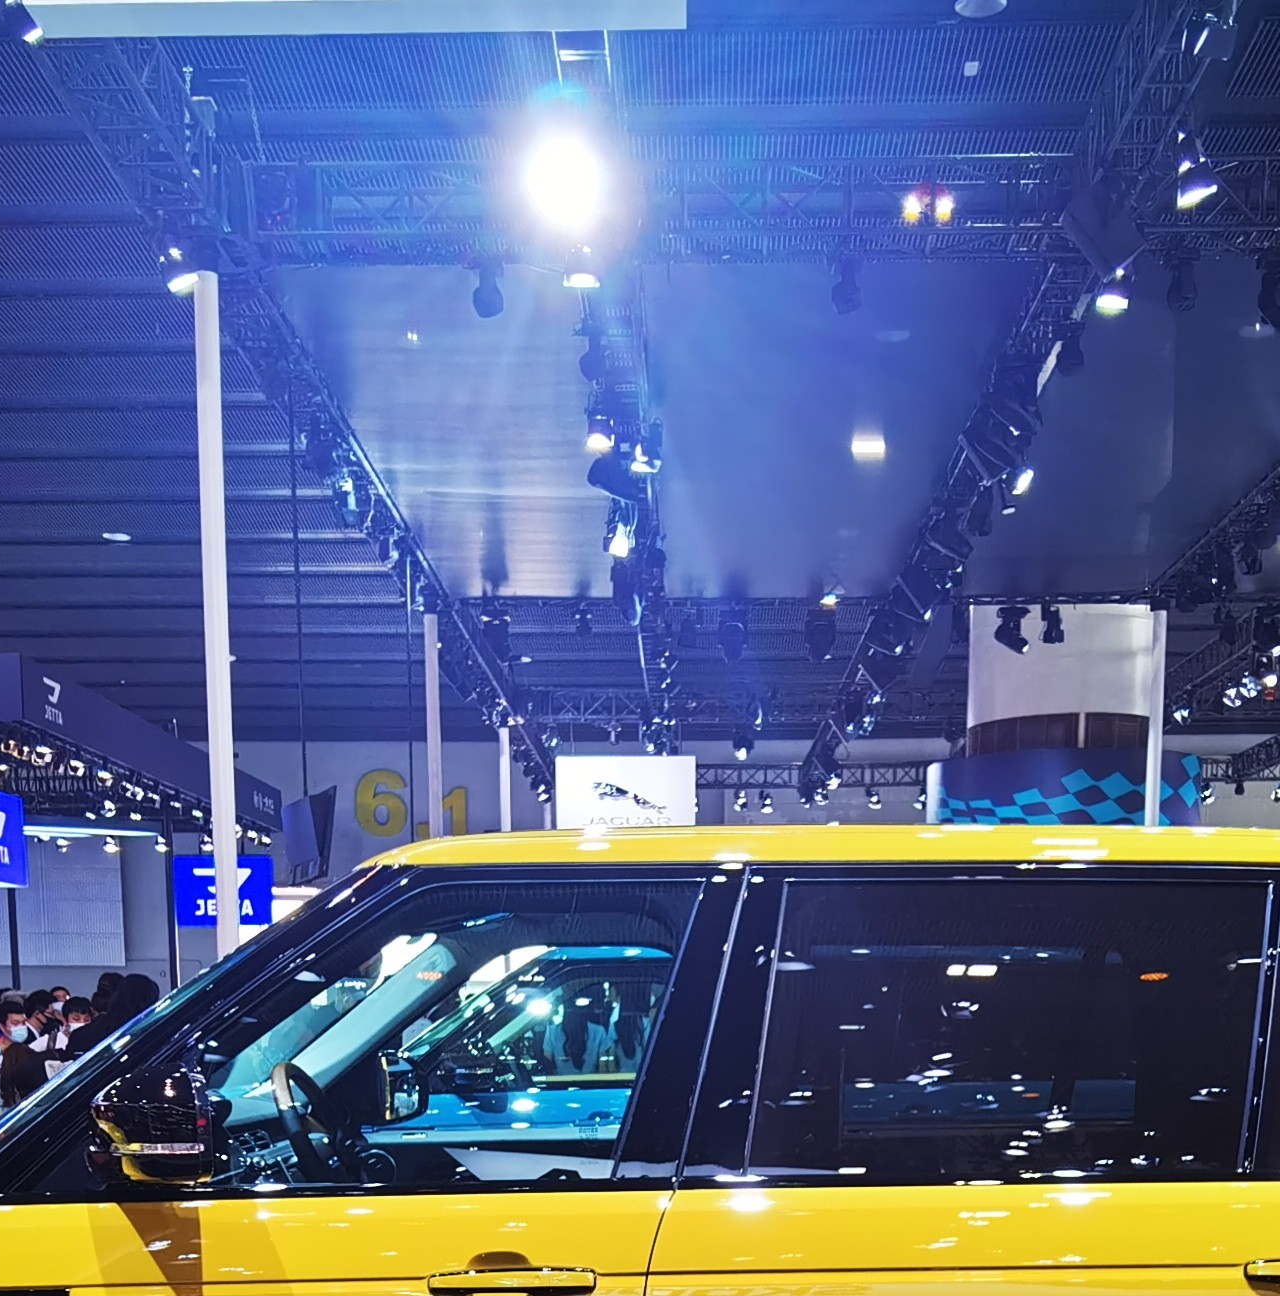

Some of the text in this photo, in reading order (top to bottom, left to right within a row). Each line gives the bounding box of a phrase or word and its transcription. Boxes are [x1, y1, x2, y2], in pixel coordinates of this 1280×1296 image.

[44, 704, 63, 726] JETTA
[582, 816, 672, 826] JAGUAR
[195, 899, 254, 916] JEA
